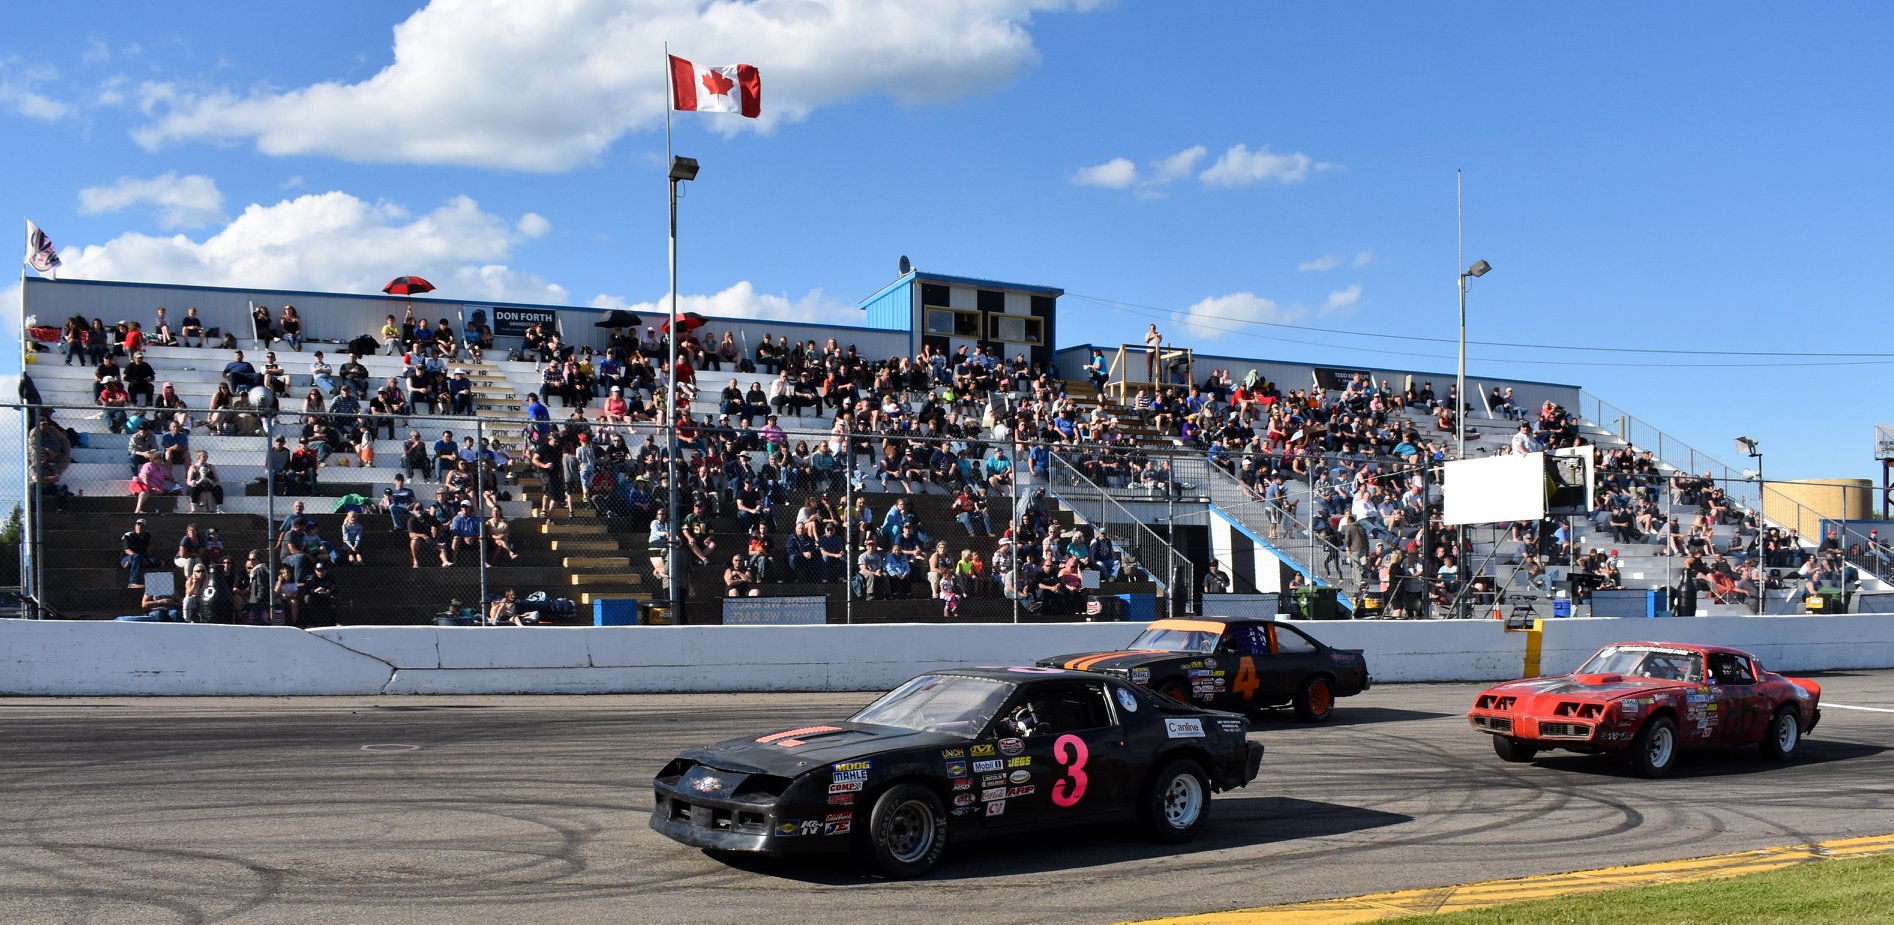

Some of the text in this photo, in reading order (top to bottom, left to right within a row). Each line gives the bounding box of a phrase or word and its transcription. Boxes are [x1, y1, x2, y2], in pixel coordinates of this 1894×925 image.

[496, 311, 552, 322] DON FORTH
[1232, 655, 1260, 701] 4
[941, 748, 965, 758] UNOH
[835, 761, 870, 771] MOOG
[975, 762, 994, 770] Mobil
[1008, 756, 1031, 768] JEGS
[833, 770, 867, 782] MAHLE
[1051, 733, 1089, 808] 3
